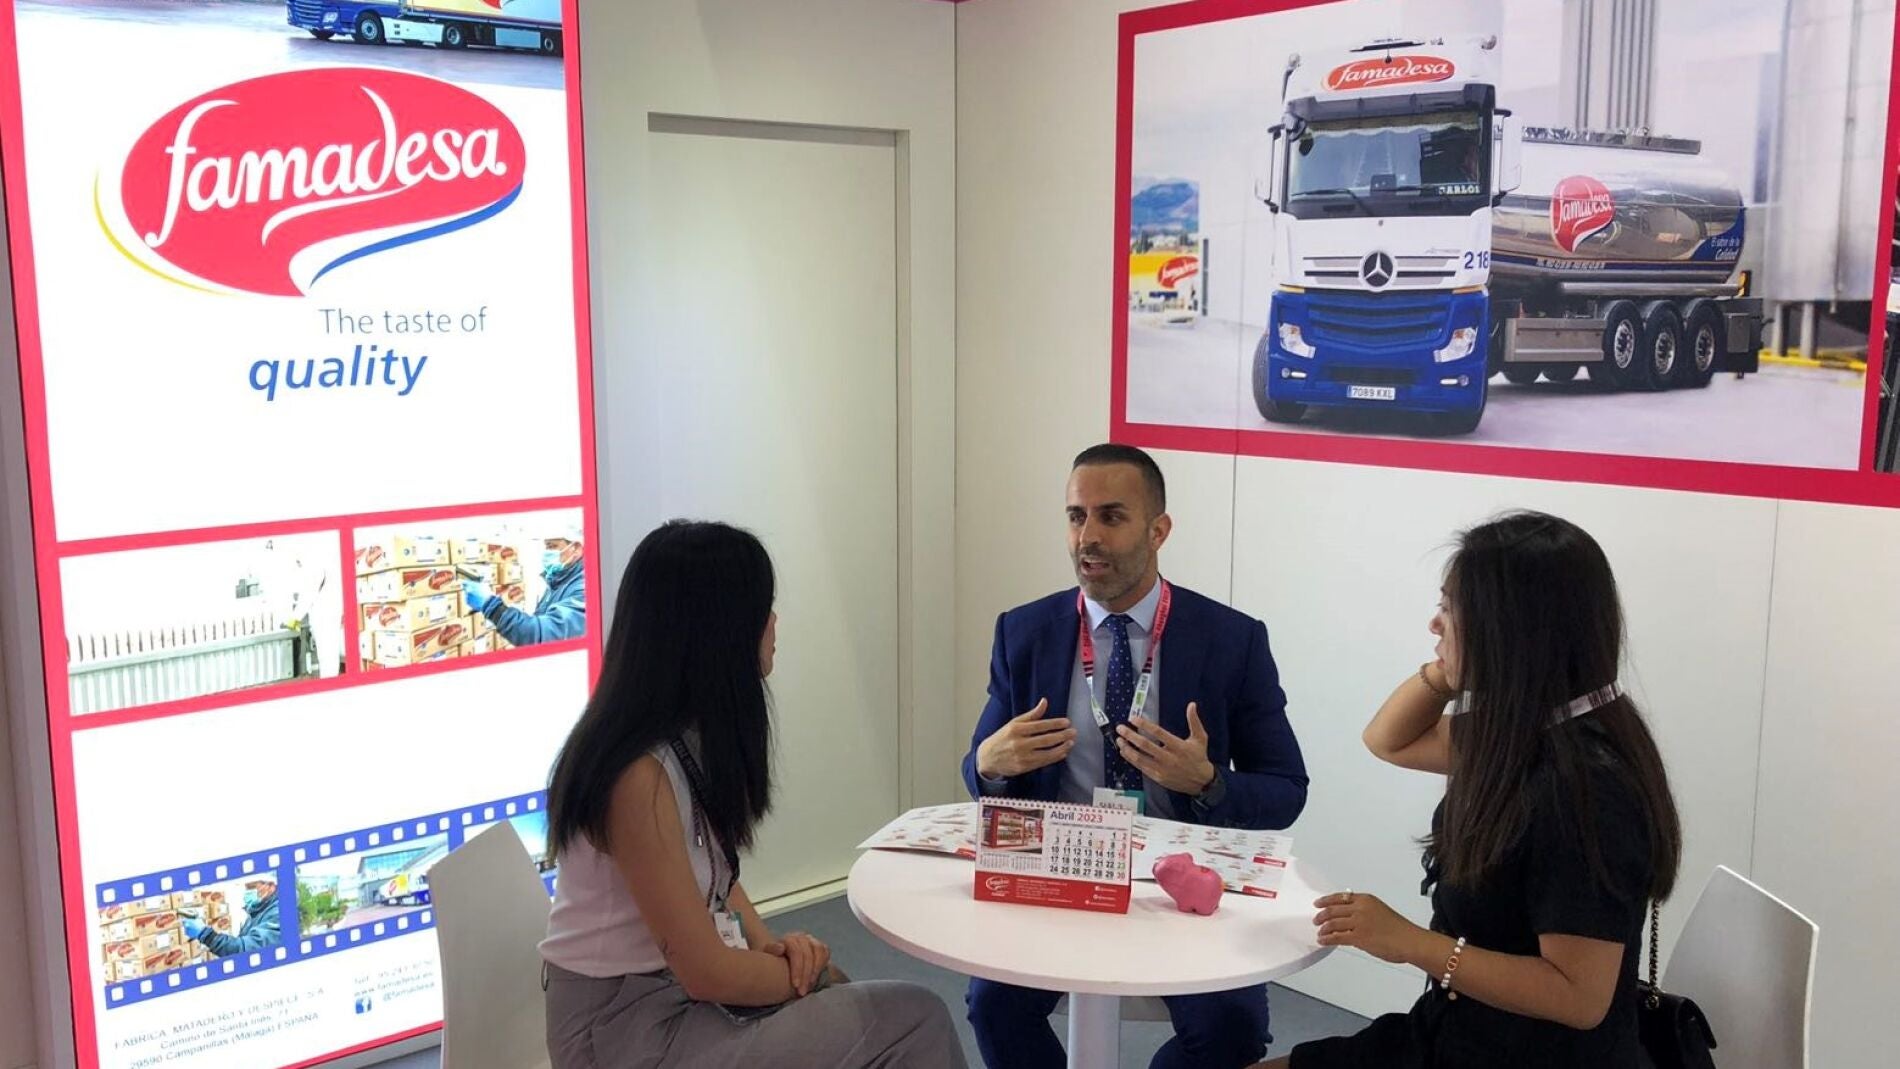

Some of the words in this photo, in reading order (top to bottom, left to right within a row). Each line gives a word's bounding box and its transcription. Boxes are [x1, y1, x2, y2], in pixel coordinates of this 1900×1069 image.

[1332, 58, 1449, 88] famadesa
[146, 86, 507, 247] famadesa
[319, 309, 374, 335] The
[383, 309, 452, 334] taste
[460, 306, 488, 333] of
[249, 345, 428, 401] quality
[1050, 810, 1075, 821] Abril
[1077, 812, 1103, 824] 2023
